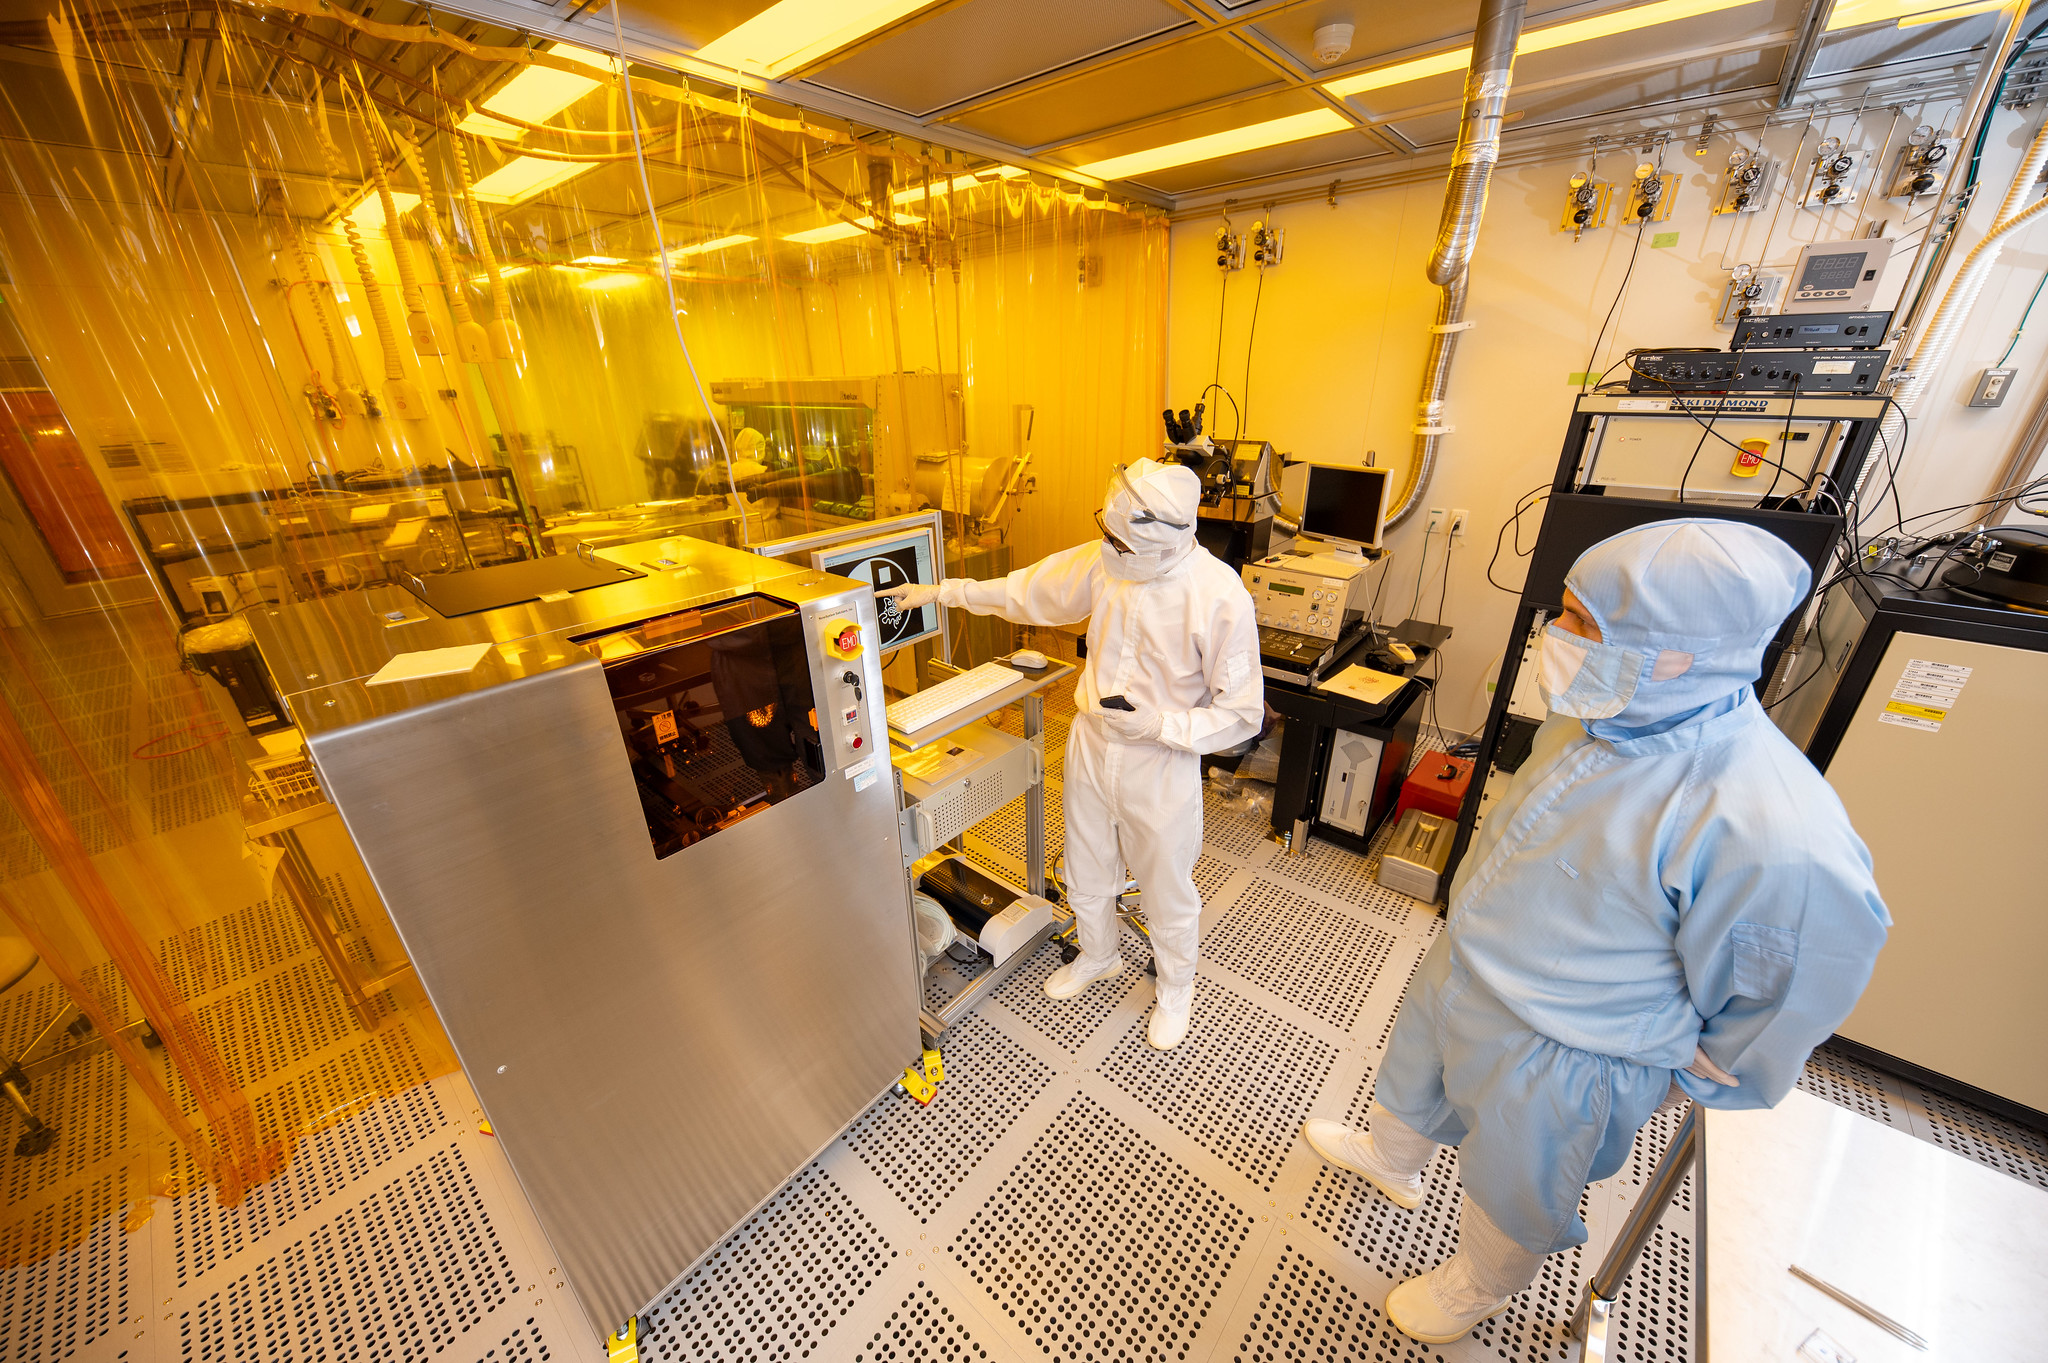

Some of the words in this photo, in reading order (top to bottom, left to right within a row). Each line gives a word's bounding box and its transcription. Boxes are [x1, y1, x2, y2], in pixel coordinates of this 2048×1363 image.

[1703, 399, 1769, 407] DIAMOND
[1741, 453, 1761, 464] EMO
[841, 634, 857, 650] EMO
